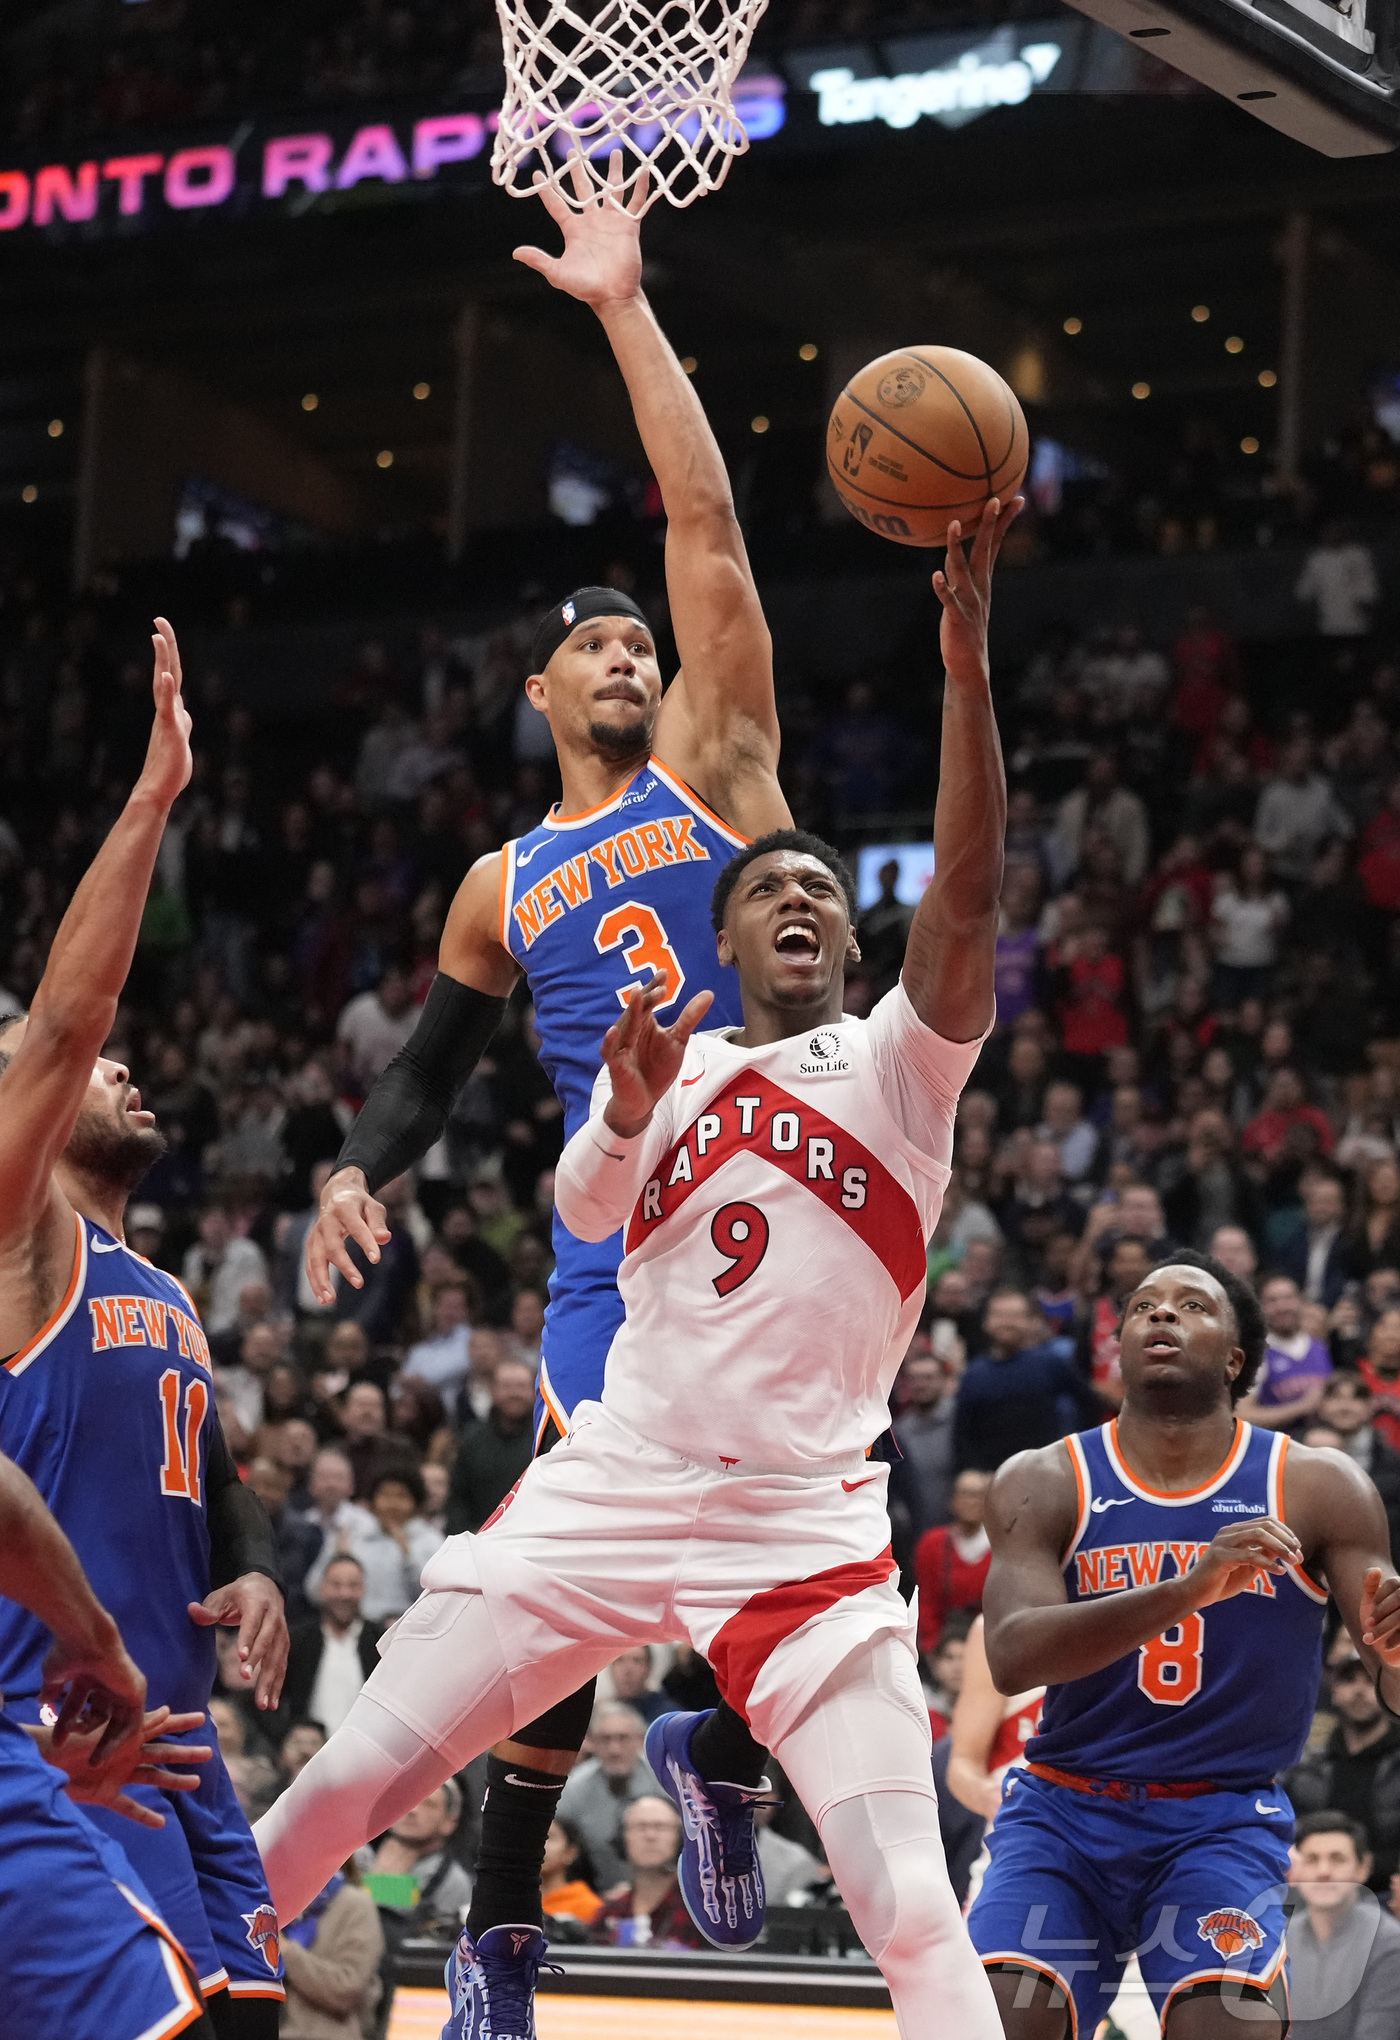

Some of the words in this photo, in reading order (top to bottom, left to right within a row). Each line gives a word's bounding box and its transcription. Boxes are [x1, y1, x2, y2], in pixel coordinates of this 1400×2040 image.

[512, 851, 593, 951] NEW
[588, 814, 711, 889] YORK
[593, 900, 686, 1013] 3
[800, 1063, 823, 1074] Sun
[827, 1060, 849, 1071] Life
[642, 1096, 868, 1221] RAPTORS
[710, 1201, 769, 1298] 9
[89, 1296, 168, 1352] NEW
[159, 1368, 208, 1507] 11
[1075, 1542, 1166, 1596] NEW
[1137, 1611, 1205, 1706] 8
[1201, 1913, 1260, 1945] KNICKS
